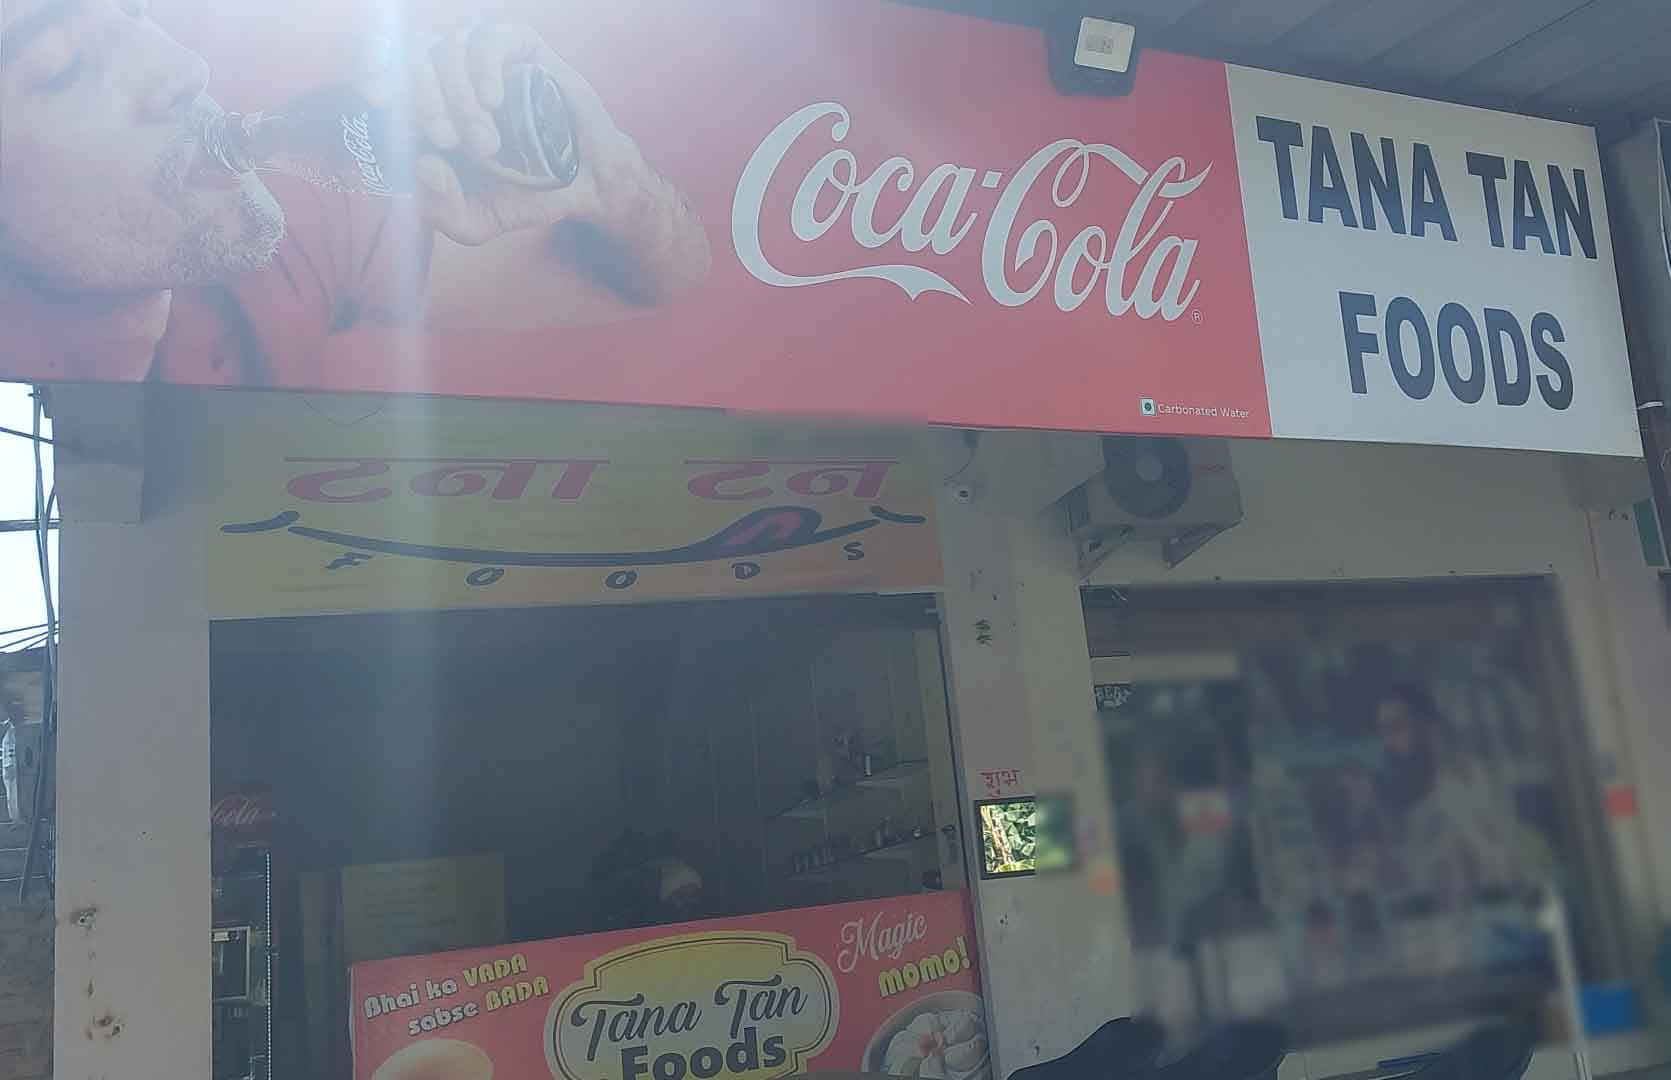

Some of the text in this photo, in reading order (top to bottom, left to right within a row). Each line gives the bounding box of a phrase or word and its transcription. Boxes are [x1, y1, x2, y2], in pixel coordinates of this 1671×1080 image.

[731, 102, 1214, 321] Coca-Cola
[1255, 115, 1597, 259] TANA TAN
[1338, 290, 1573, 410] FOODS
[1158, 403, 1249, 418] Carbonated Water
[284, 457, 899, 502] टना टन
[837, 911, 928, 973] Magic
[365, 953, 528, 1018] Bhai ka VADA
[408, 976, 549, 1035] sabse BADA
[570, 974, 809, 1062] Tana Tan
[620, 1026, 787, 1080] Foods
